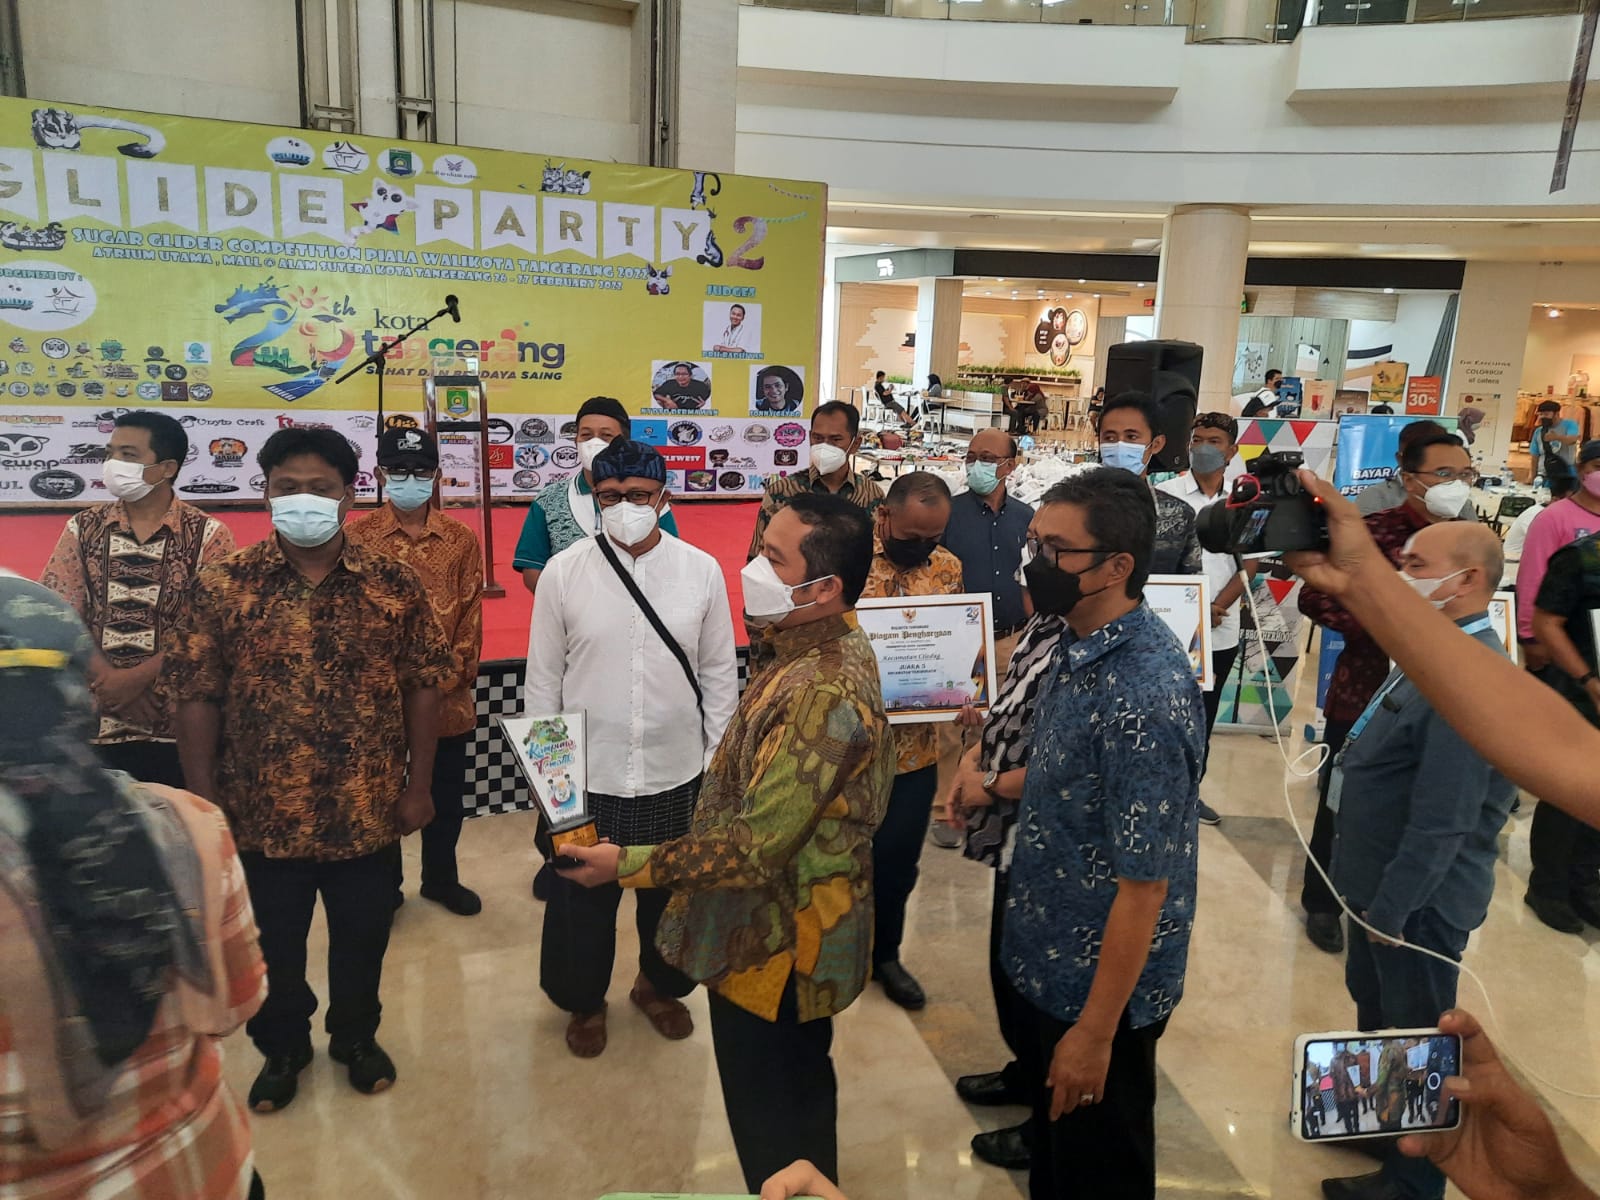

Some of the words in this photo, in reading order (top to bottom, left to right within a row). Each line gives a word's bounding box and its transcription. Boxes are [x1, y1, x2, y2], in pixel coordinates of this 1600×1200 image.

[71, 228, 143, 246] SUGAR
[147, 233, 223, 252] GLIDER
[227, 238, 361, 260] COMPETITION
[365, 247, 418, 264] PIALA
[422, 252, 514, 271] WALIKOTA
[518, 260, 614, 278] TANGERANG
[617, 267, 649, 280] 2022
[93, 247, 155, 260] ATRIUM
[159, 251, 213, 264] UTAMA
[222, 254, 262, 267] MALL
[278, 258, 317, 271] ALAM
[320, 261, 372, 275] SUTERA
[374, 264, 413, 277] KOTA
[415, 267, 491, 282] TANGERANG
[493, 273, 507, 283] 26
[517, 274, 529, 284] 27
[532, 275, 597, 288] FEBRUARY
[706, 284, 756, 298] JUDGES
[373, 308, 430, 331] kota
[520, 371, 562, 380] SAING
[1353, 467, 1391, 480] BAYAR
